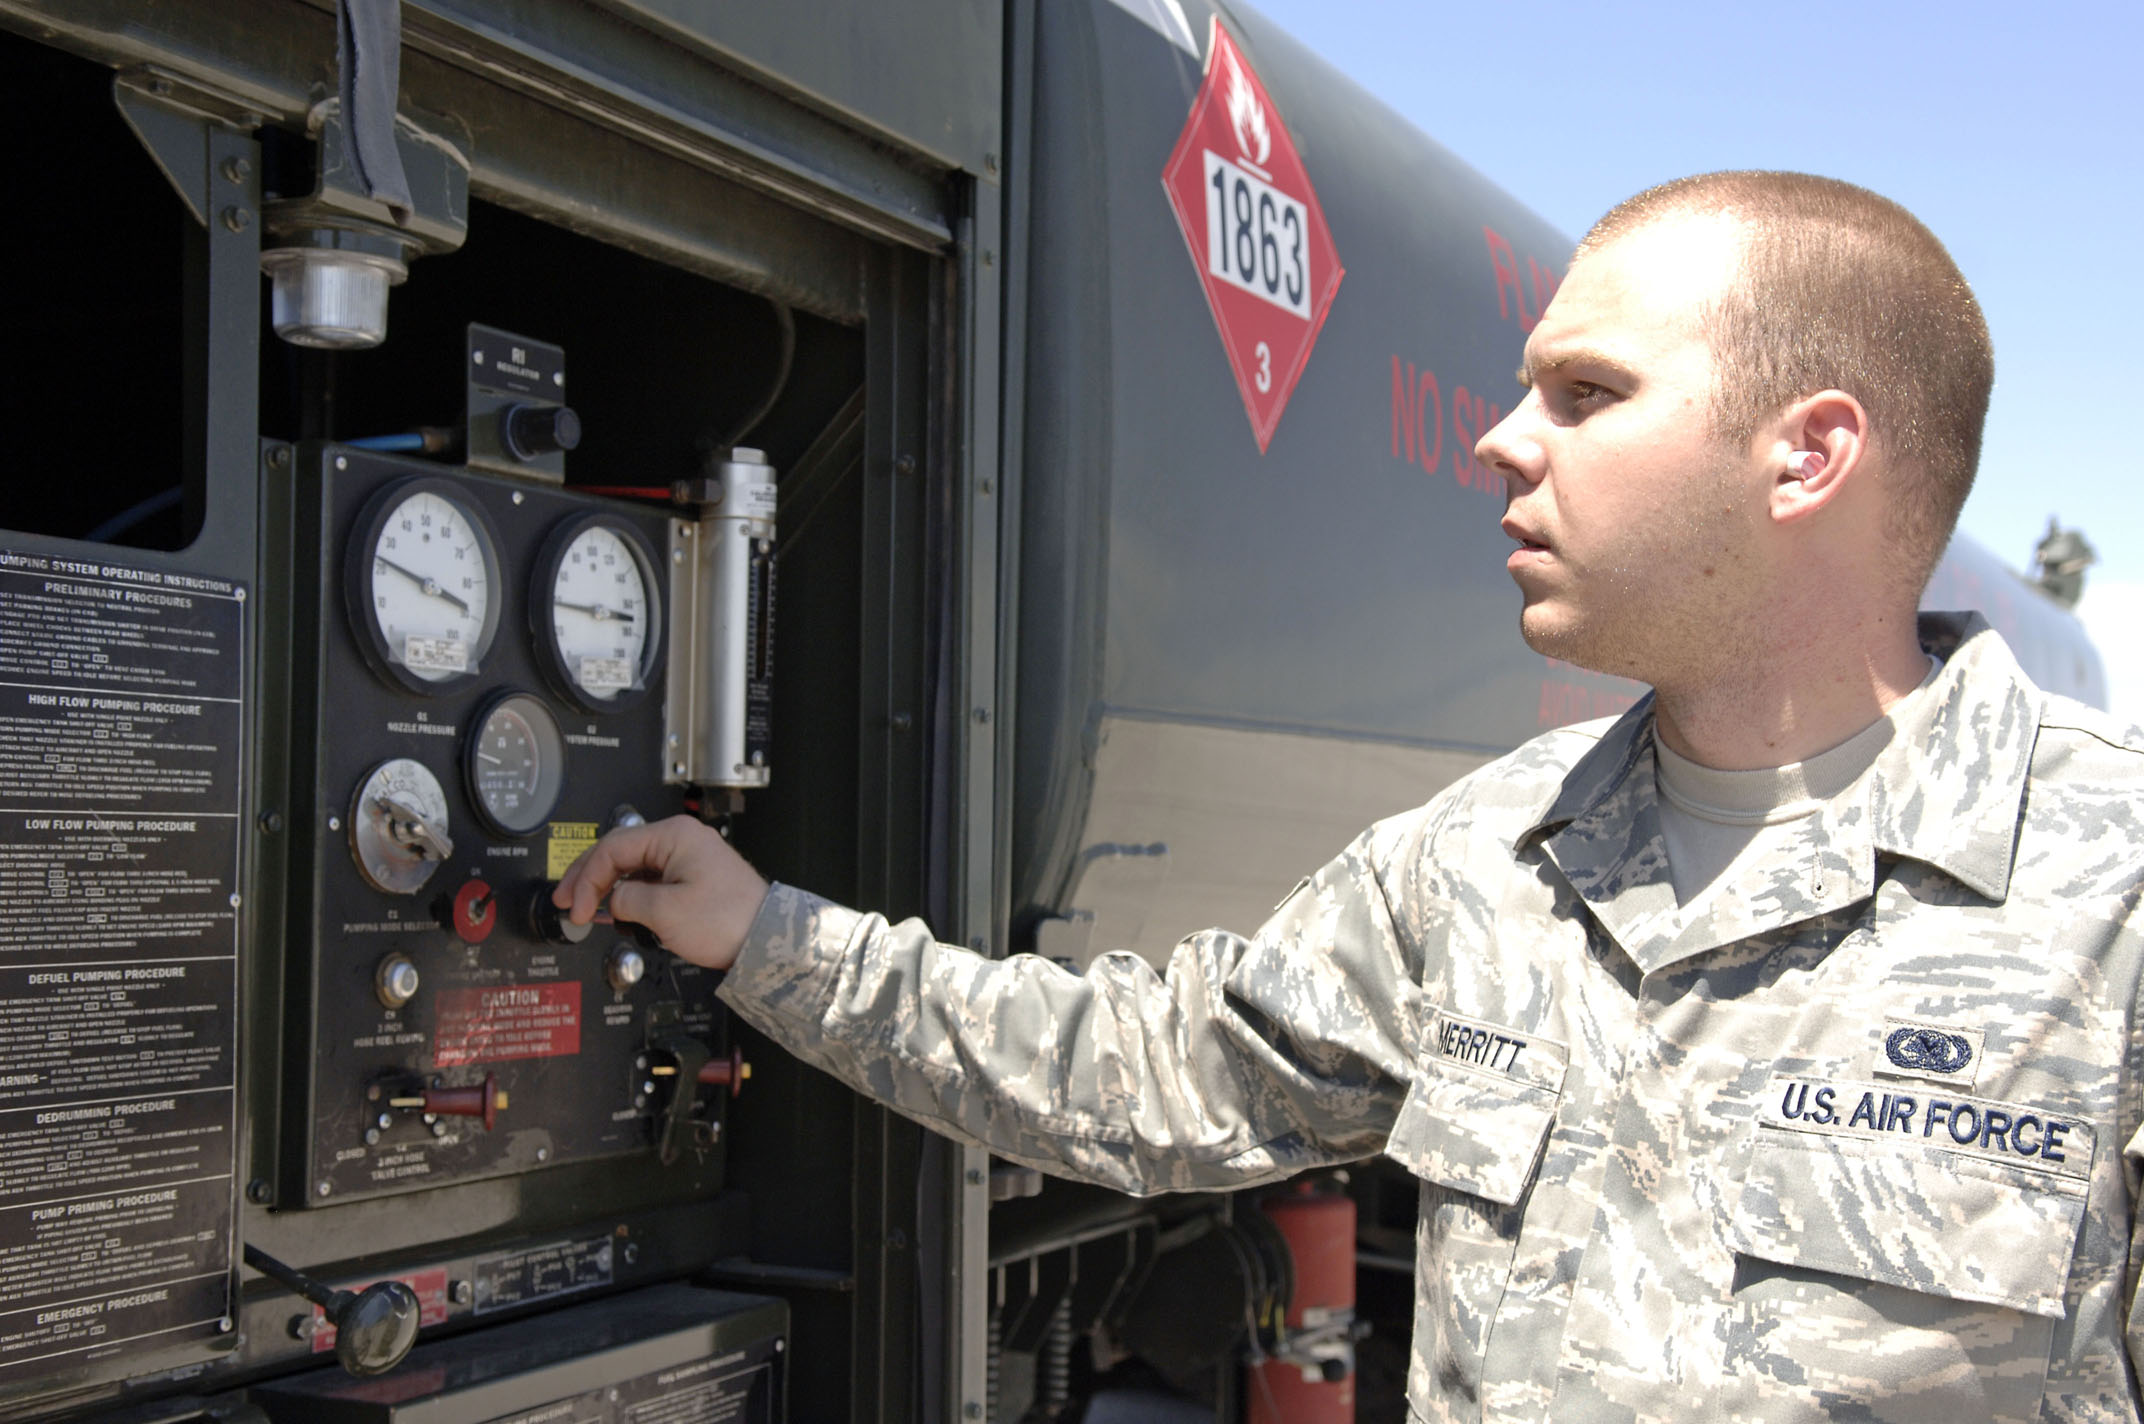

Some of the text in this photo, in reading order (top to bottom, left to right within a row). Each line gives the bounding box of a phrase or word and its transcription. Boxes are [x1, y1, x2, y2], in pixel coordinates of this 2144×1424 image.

[1212, 166, 1305, 306] 1863
[1255, 341, 1271, 394] 3
[1391, 353, 1442, 475] NO
[52, 560, 99, 576] SYSTEM
[102, 566, 162, 583] OPERATING
[164, 574, 232, 592] INSTRUCTIONS
[44, 582, 122, 600] PRELIMINARY
[125, 592, 192, 608] PROCEDURES
[28, 694, 202, 716] HIGH FLOW PUMPING PROCEDURE
[566, 734, 587, 745] YSTEM
[25, 819, 196, 832] LOW FLOW PUMPING PROCEDURE
[28, 967, 186, 985] DEFUEL PUMPING PROCEDURE
[481, 990, 540, 1007] CAUTION
[1438, 1019, 1527, 1072] MERRITT
[37, 1099, 176, 1125] DEDRUMMING PROCEDURE
[1782, 1083, 2071, 1163] U.S. AIR FORCE
[32, 1190, 178, 1221] PUMP PRIMING PROCEDURE
[37, 1290, 169, 1325] EMERGENCY PROCEDURE
